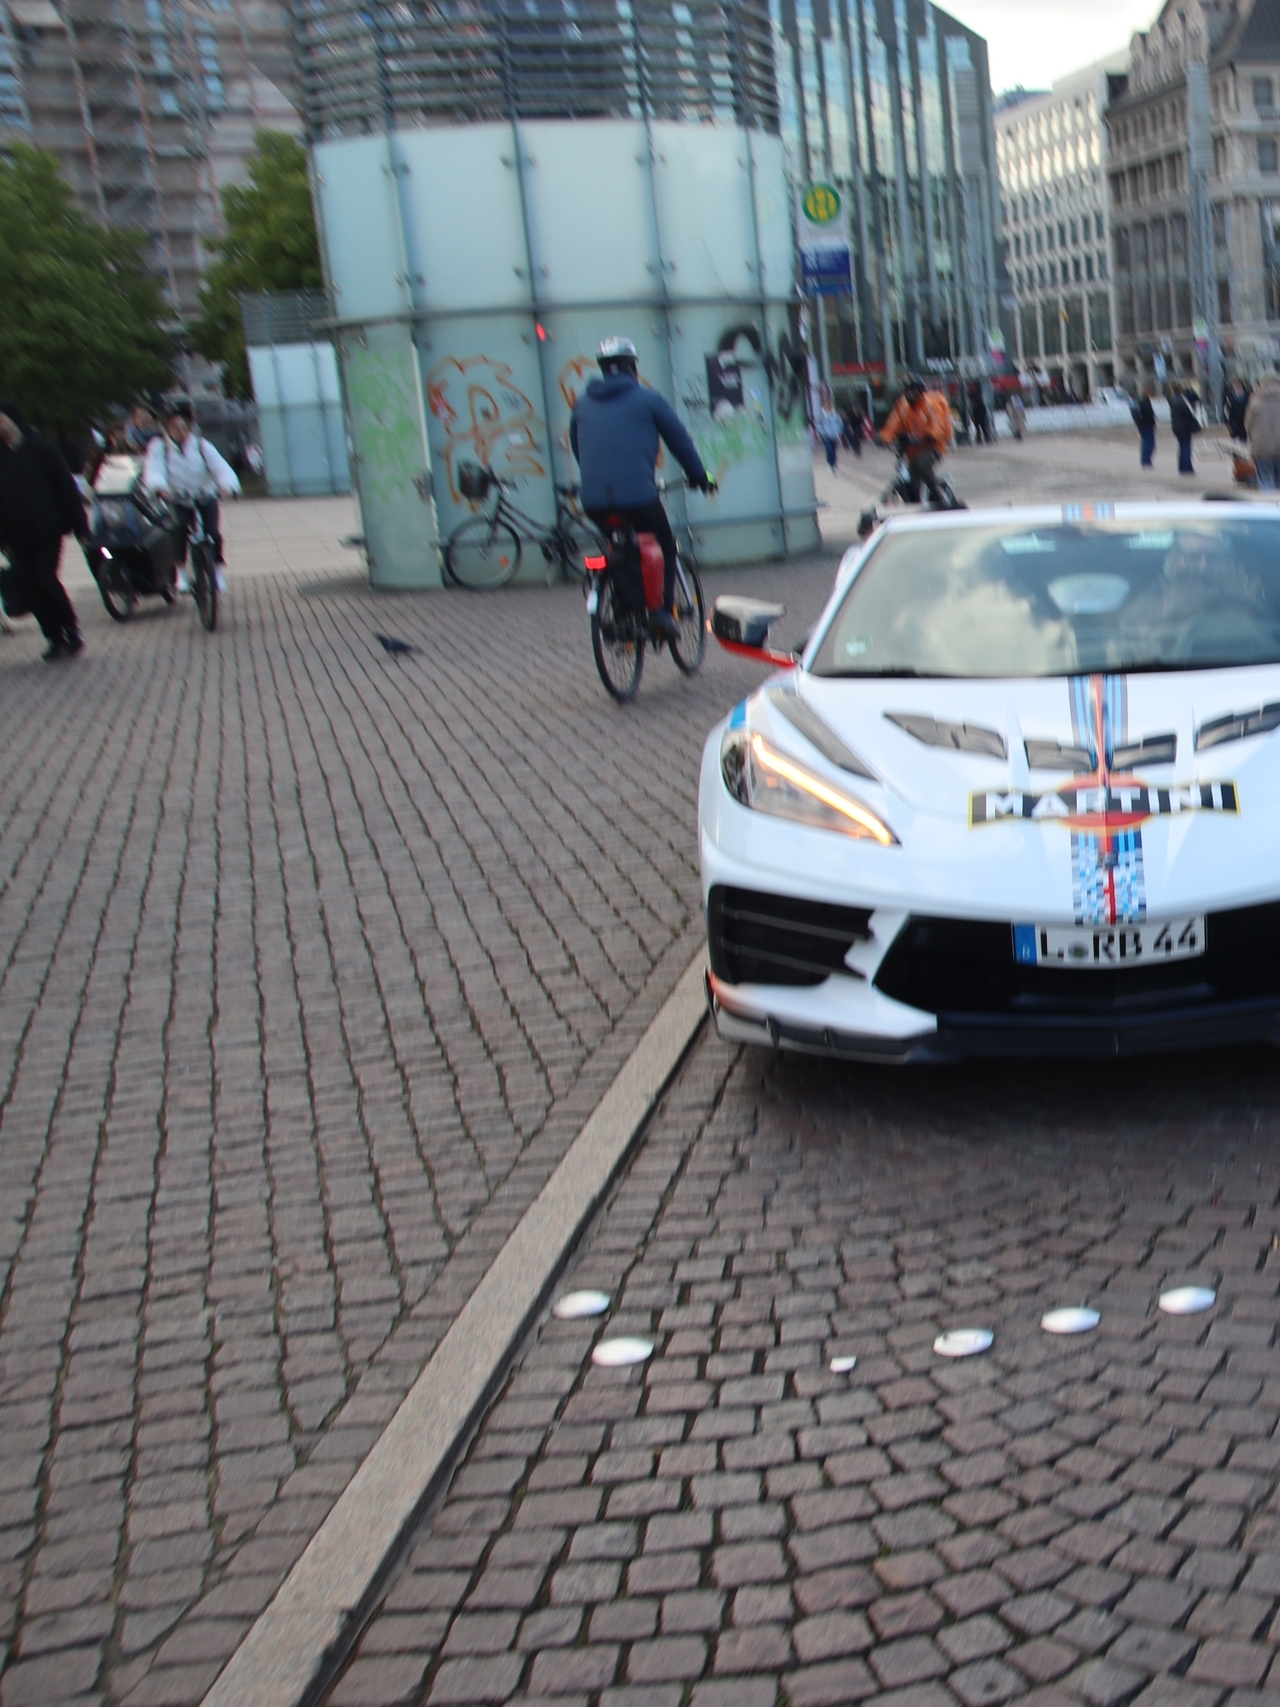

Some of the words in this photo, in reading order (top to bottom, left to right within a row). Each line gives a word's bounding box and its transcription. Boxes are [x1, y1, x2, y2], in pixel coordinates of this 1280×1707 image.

[986, 781, 1224, 821] MARTINI
[1093, 926, 1144, 962] RB
[1153, 917, 1198, 956] 44
